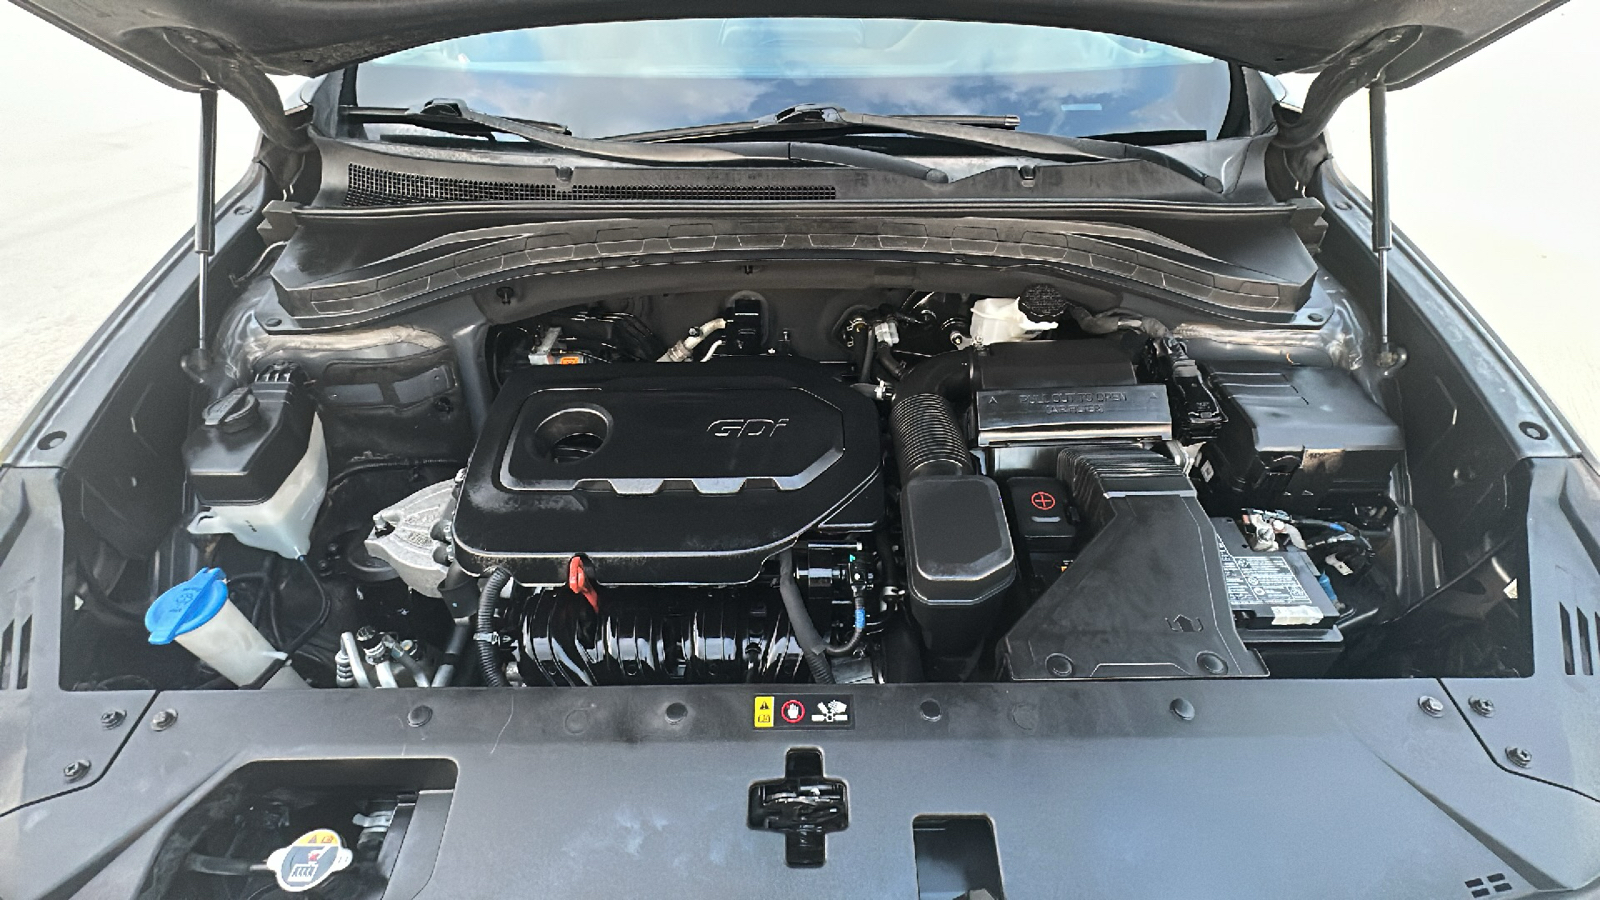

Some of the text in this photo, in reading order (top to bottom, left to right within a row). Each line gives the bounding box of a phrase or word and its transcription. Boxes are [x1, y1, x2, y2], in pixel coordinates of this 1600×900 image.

[1019, 391, 1128, 405] PULL OUT TO OPEN
